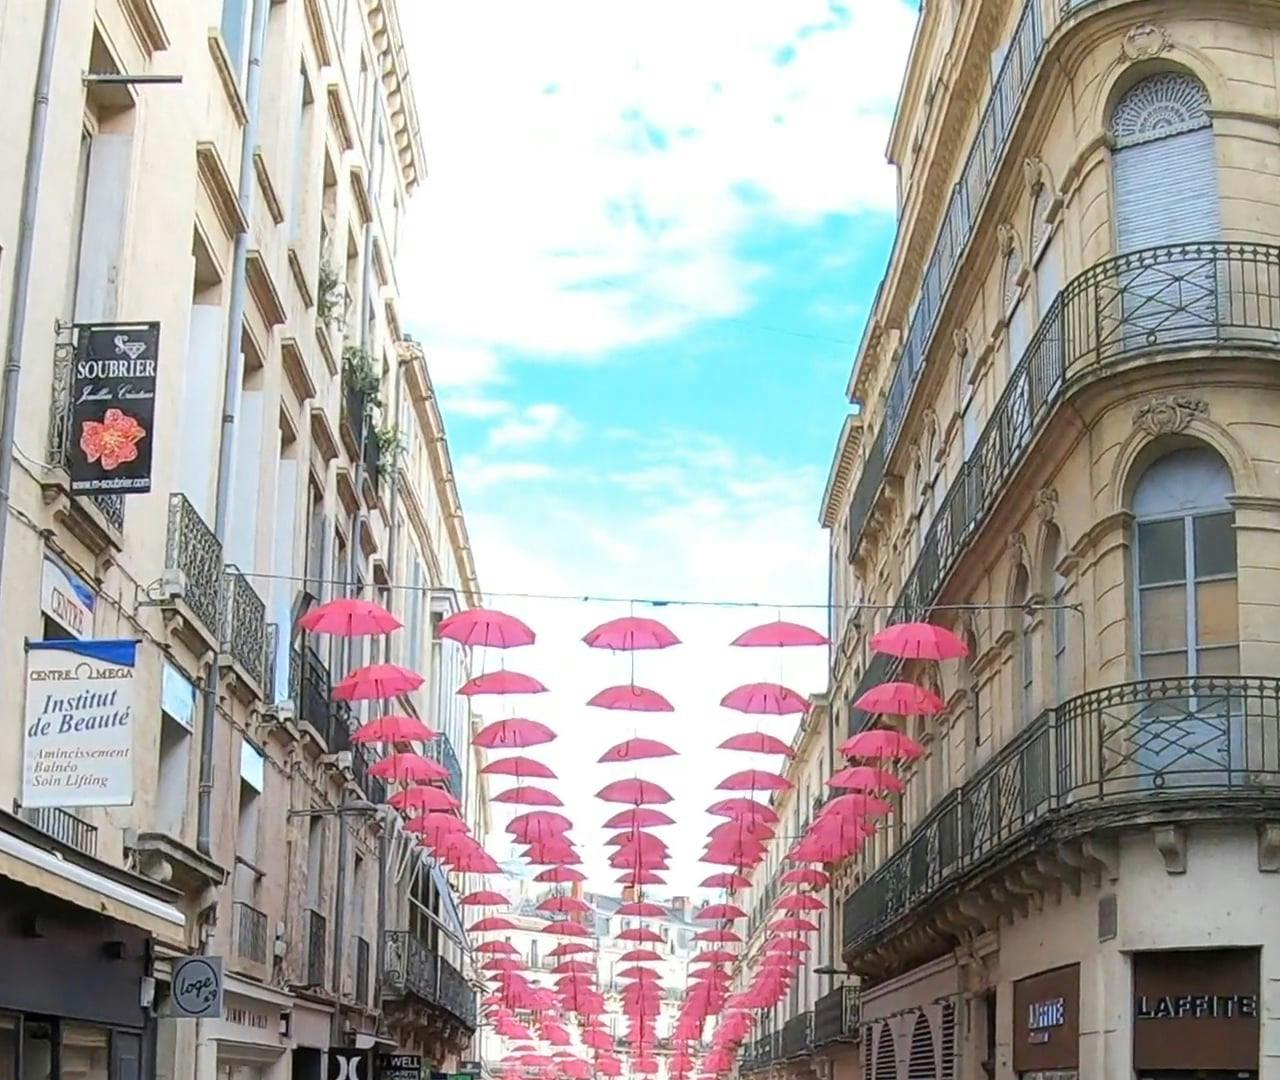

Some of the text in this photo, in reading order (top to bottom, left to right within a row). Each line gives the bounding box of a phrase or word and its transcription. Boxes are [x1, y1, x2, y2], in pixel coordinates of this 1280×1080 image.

[76, 360, 156, 379] SOUBRIER
[29, 670, 72, 681] CENTRE
[42, 689, 118, 715] Institut
[27, 705, 131, 738] de Beauté
[34, 746, 130, 760] Amincissement
[33, 760, 79, 774] Balnéo
[32, 774, 109, 789] Soin Lifting
[179, 976, 214, 999] loge
[1137, 994, 1258, 1018] LAFFITE
